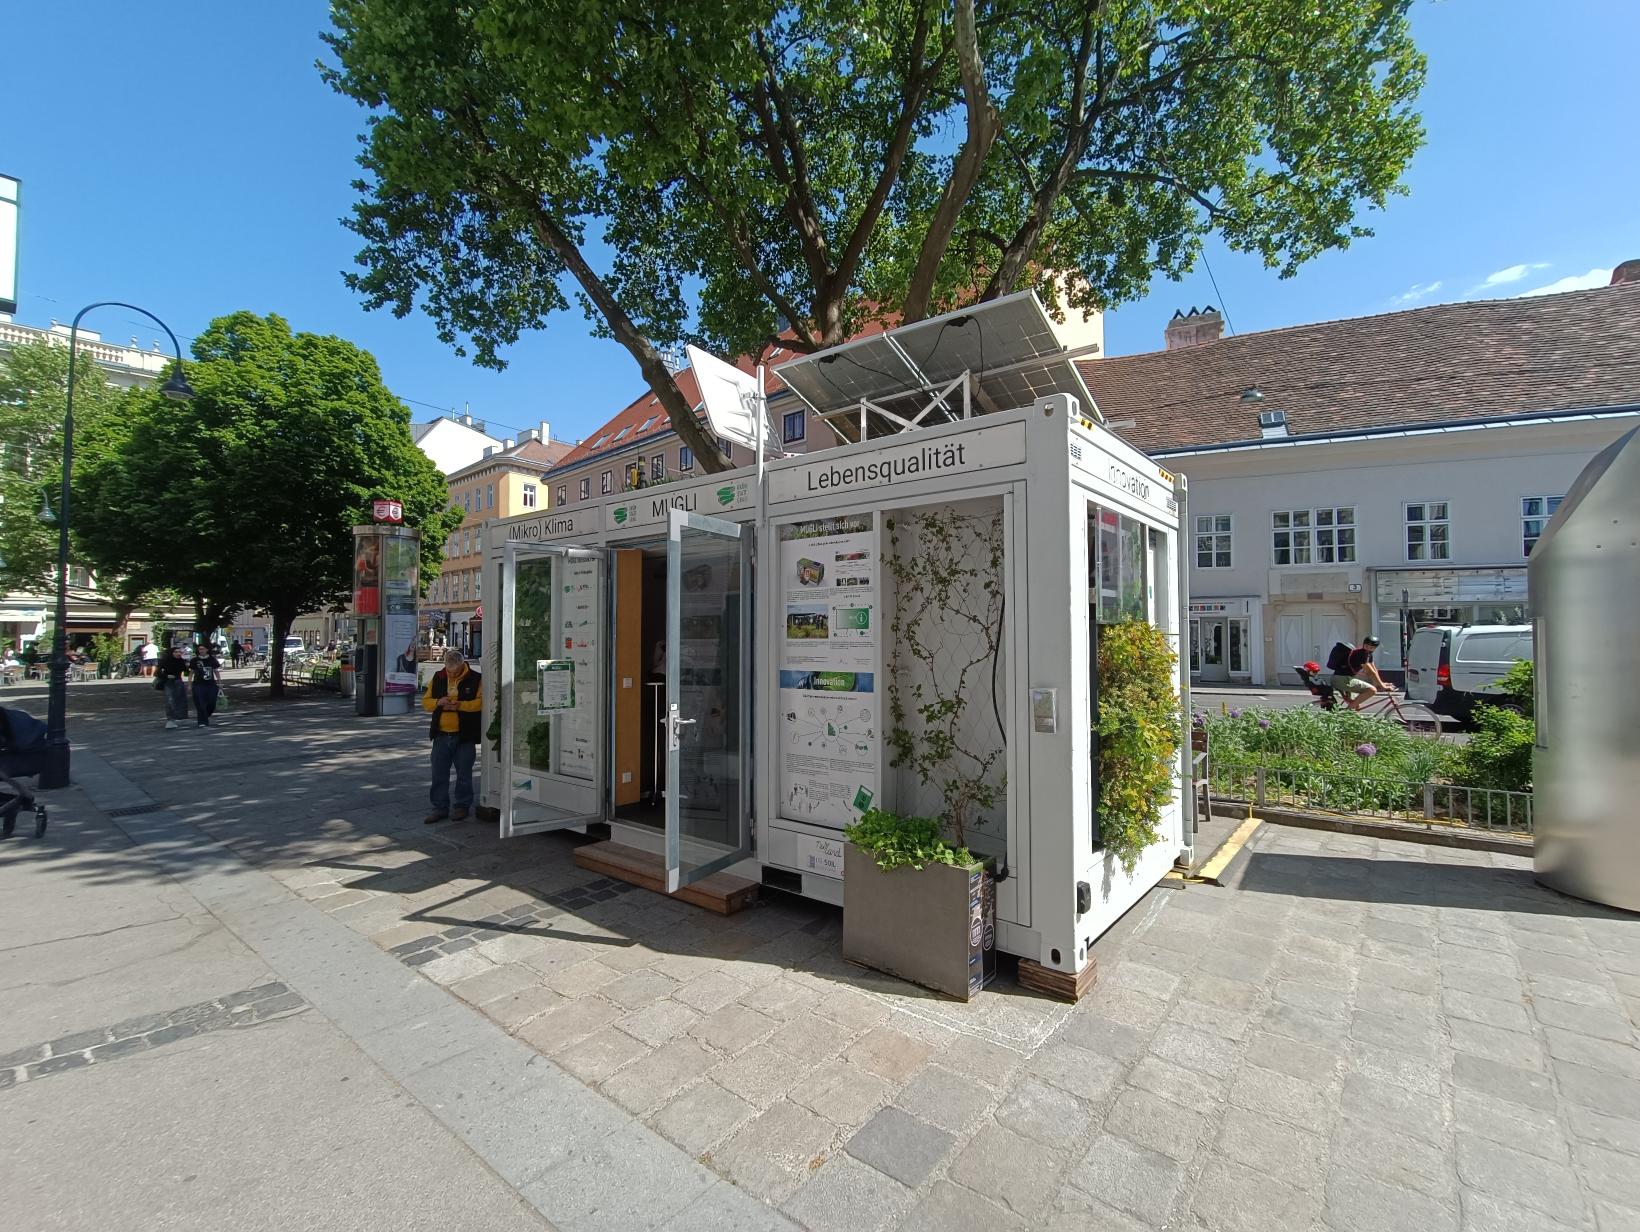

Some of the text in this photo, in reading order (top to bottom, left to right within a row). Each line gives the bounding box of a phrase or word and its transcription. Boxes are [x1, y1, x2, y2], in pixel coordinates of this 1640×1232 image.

[808, 443, 966, 491] Lebensqualität
[1108, 460, 1150, 500] Innovation
[652, 493, 697, 517] MUGLI
[509, 518, 574, 540] (Mikro) Klima
[813, 677, 845, 687] Innovation
